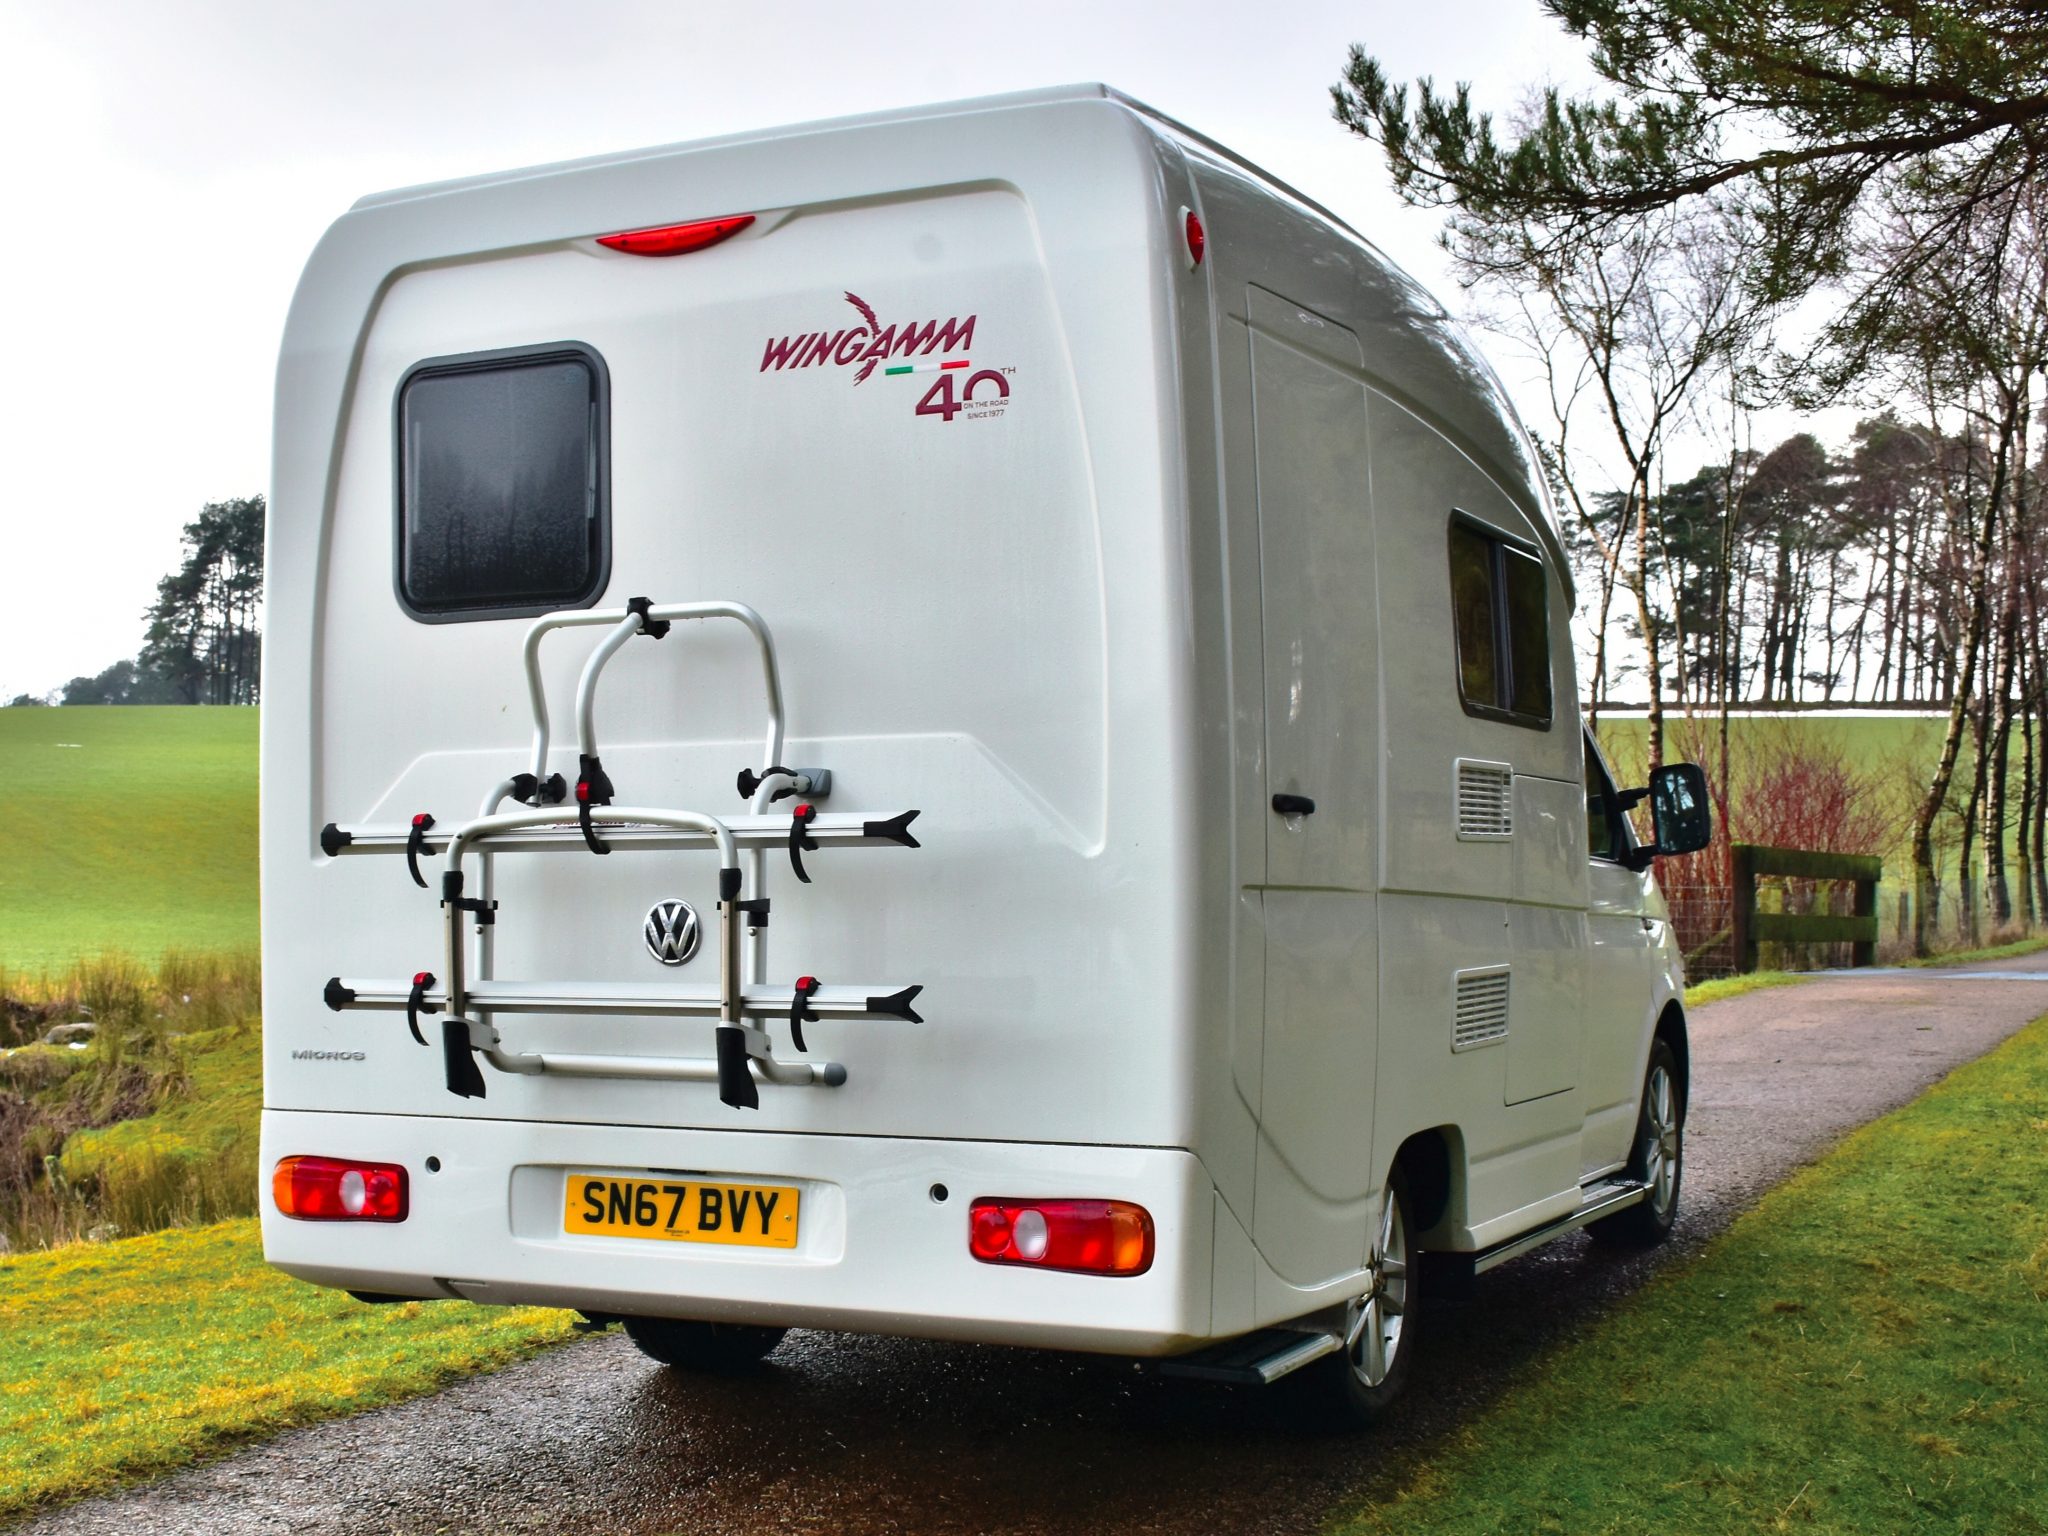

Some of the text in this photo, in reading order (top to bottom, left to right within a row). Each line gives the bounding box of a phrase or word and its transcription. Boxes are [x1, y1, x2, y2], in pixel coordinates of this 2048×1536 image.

[759, 314, 977, 373] WINGAMM
[967, 409, 1005, 420] SINCE 1977
[975, 400, 988, 408] THE
[990, 399, 1009, 407] ROAD
[582, 1181, 780, 1235] SN67 BVY
